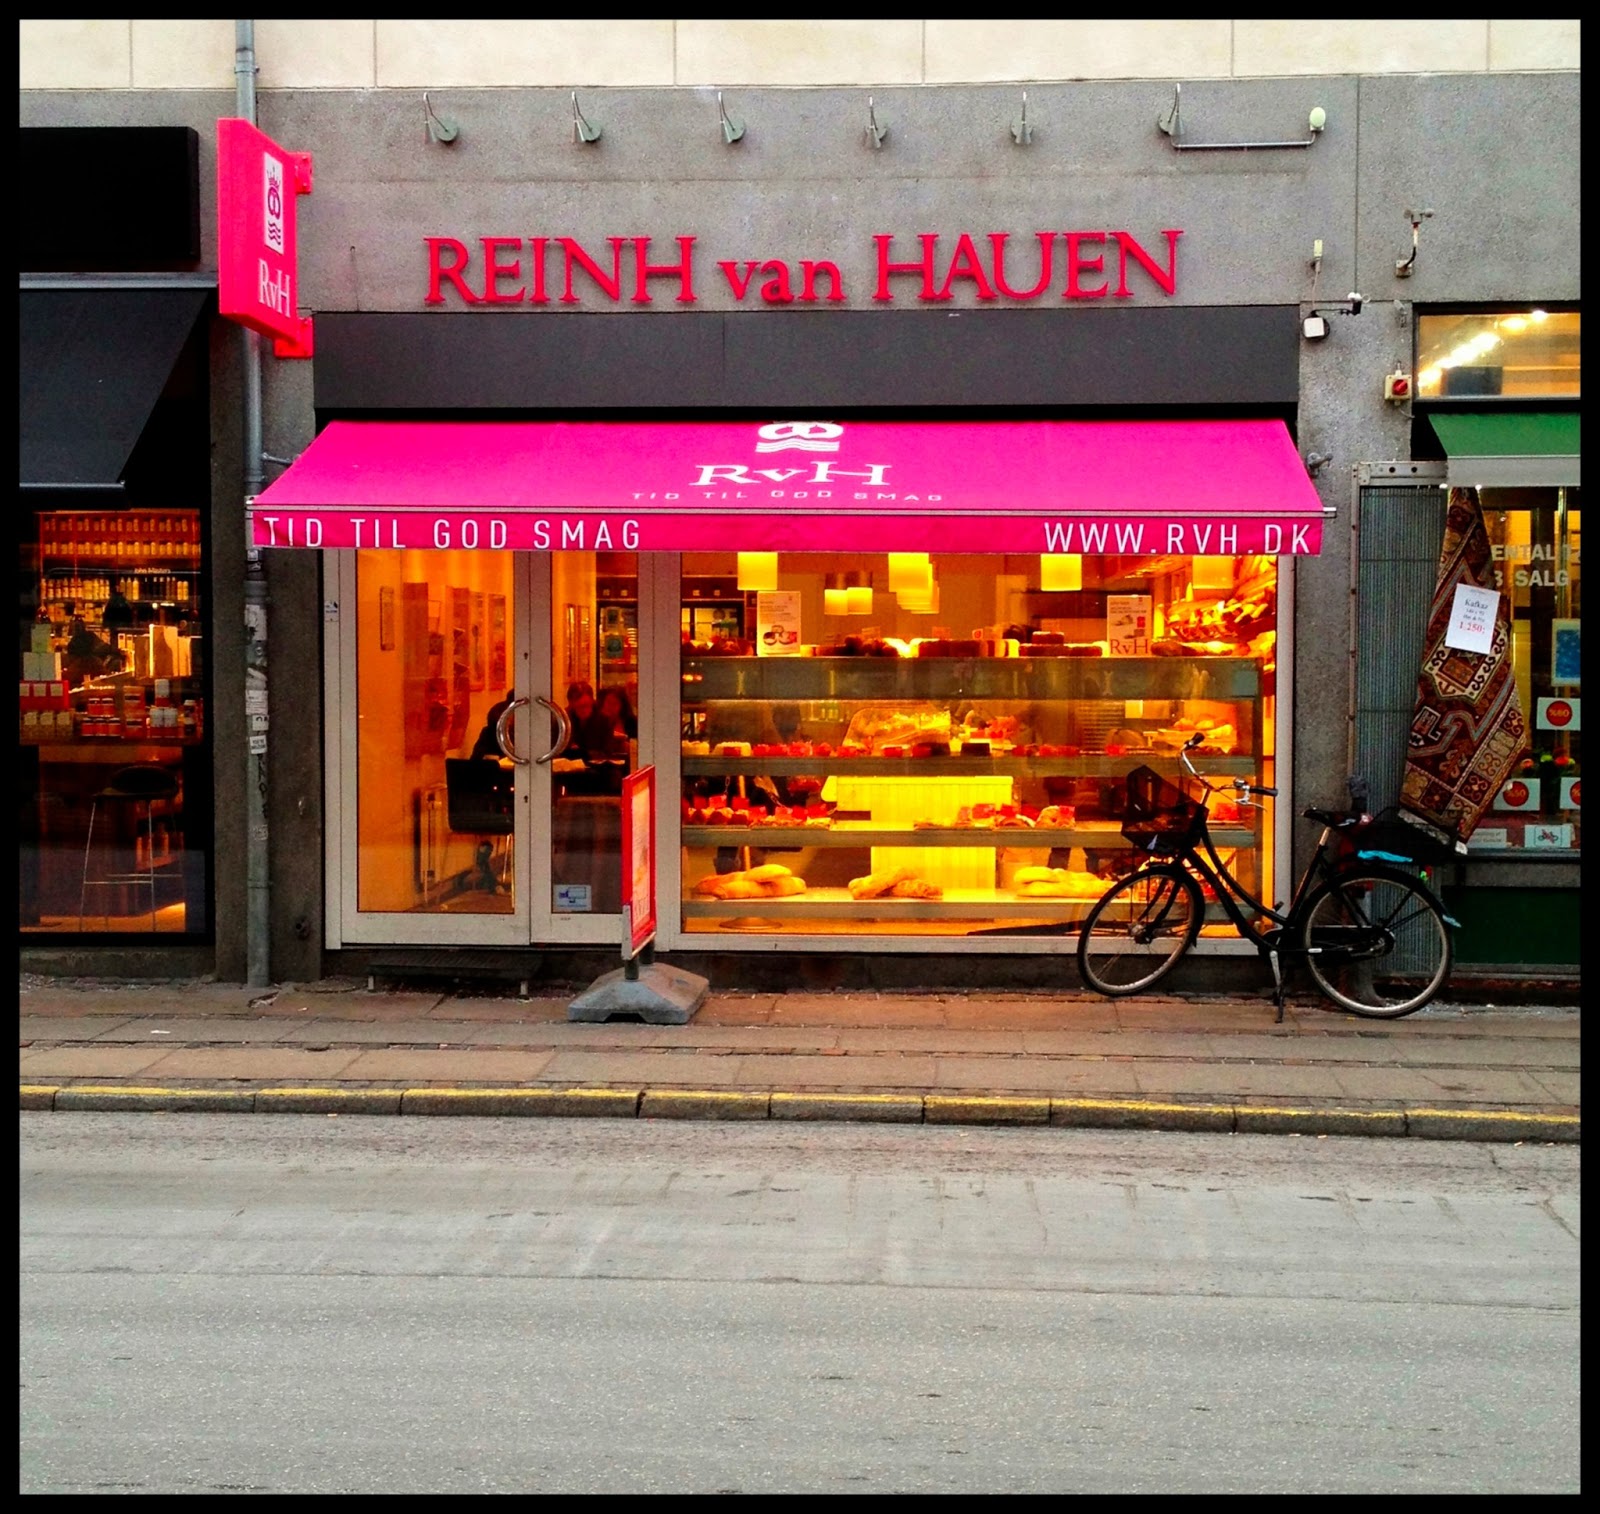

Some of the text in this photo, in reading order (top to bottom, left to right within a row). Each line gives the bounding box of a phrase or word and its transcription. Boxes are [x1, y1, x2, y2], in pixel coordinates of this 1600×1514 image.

[424, 229, 1183, 306] REINH van HAUEN
[257, 258, 292, 319] RvH
[688, 462, 892, 487] RvH
[632, 489, 944, 503] TID TIL GOD SMAG
[263, 516, 641, 551] TID TIL GOD SMAG
[1044, 521, 1312, 556] WWW.RVH.DK
[1515, 569, 1569, 587] SALG
[1109, 638, 1149, 655] RvH
